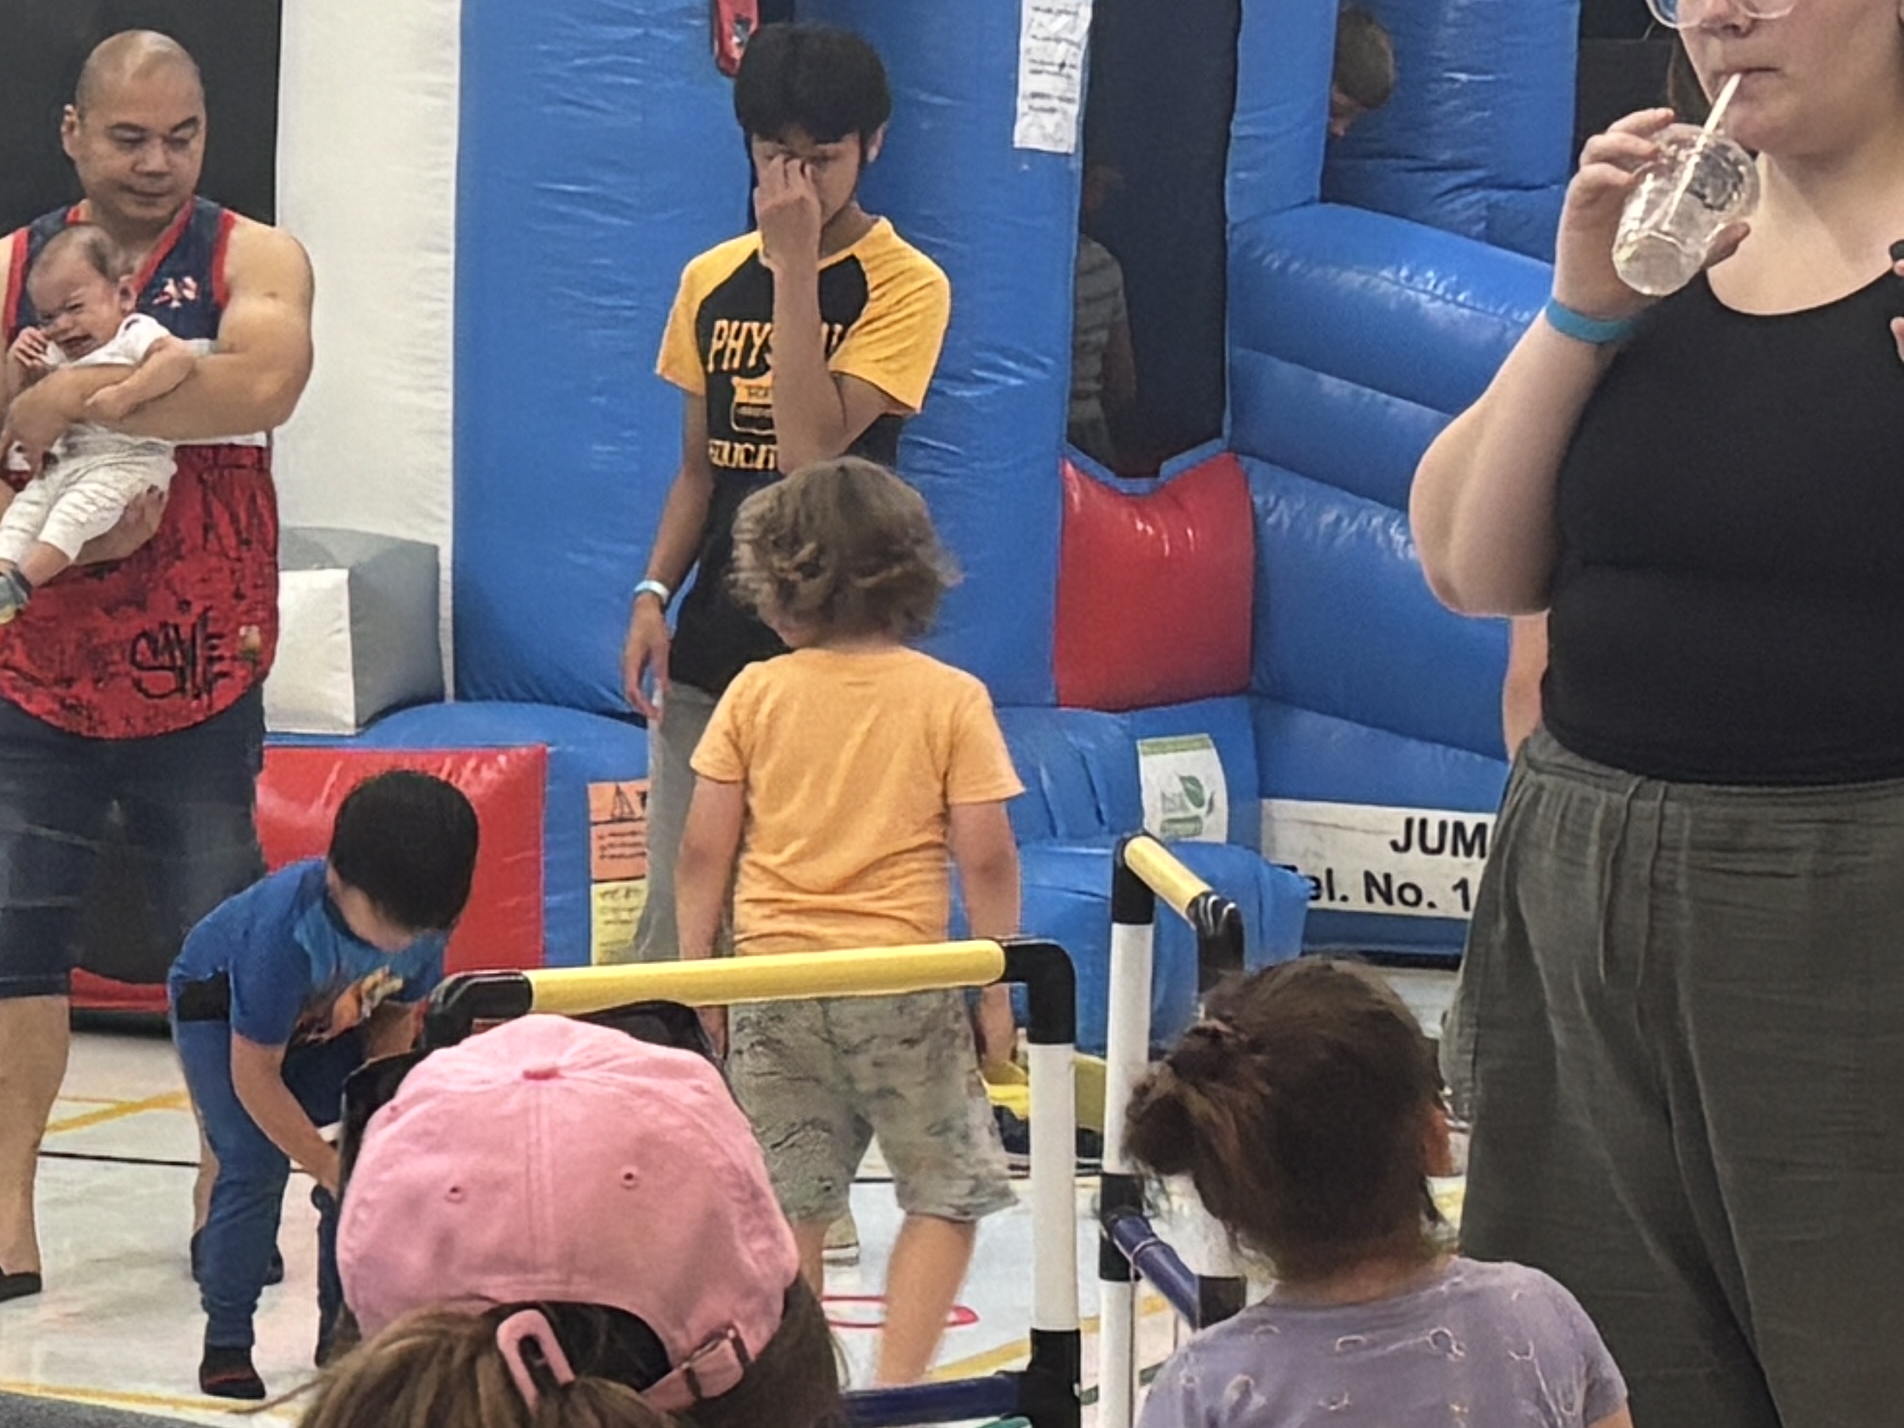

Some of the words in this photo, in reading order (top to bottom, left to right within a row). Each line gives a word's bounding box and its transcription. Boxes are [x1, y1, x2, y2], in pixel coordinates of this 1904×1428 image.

[1390, 817, 1489, 859] JUM
[1276, 864, 1349, 903] el.
[1363, 870, 1437, 910] No.
[1451, 878, 1472, 912] 1
